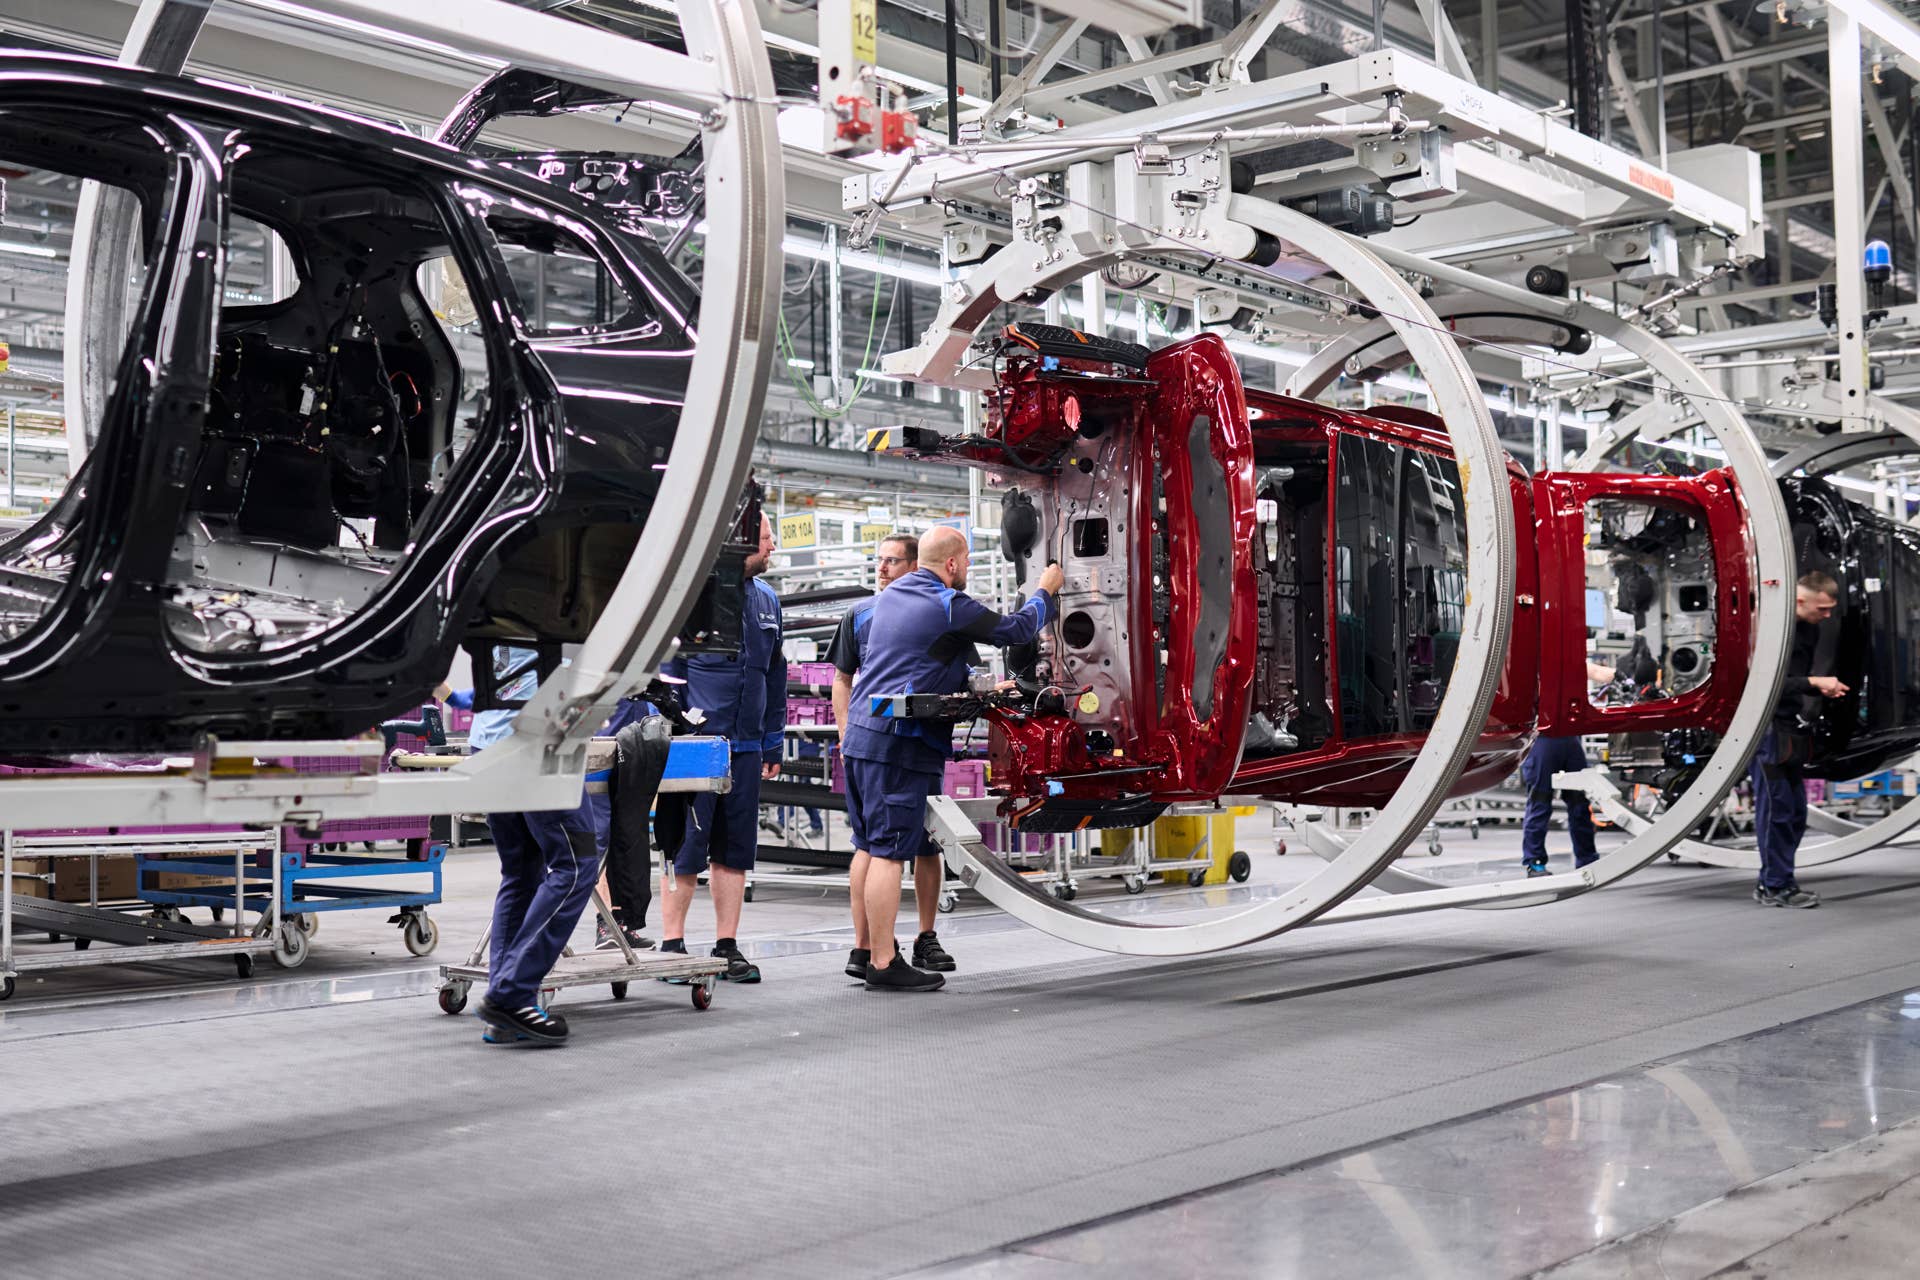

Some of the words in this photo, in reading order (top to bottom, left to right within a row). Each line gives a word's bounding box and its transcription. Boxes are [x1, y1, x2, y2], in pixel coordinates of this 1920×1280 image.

[854, 13, 874, 39] 12
[783, 523, 797, 539] 30R
[799, 521, 813, 537] 10A
